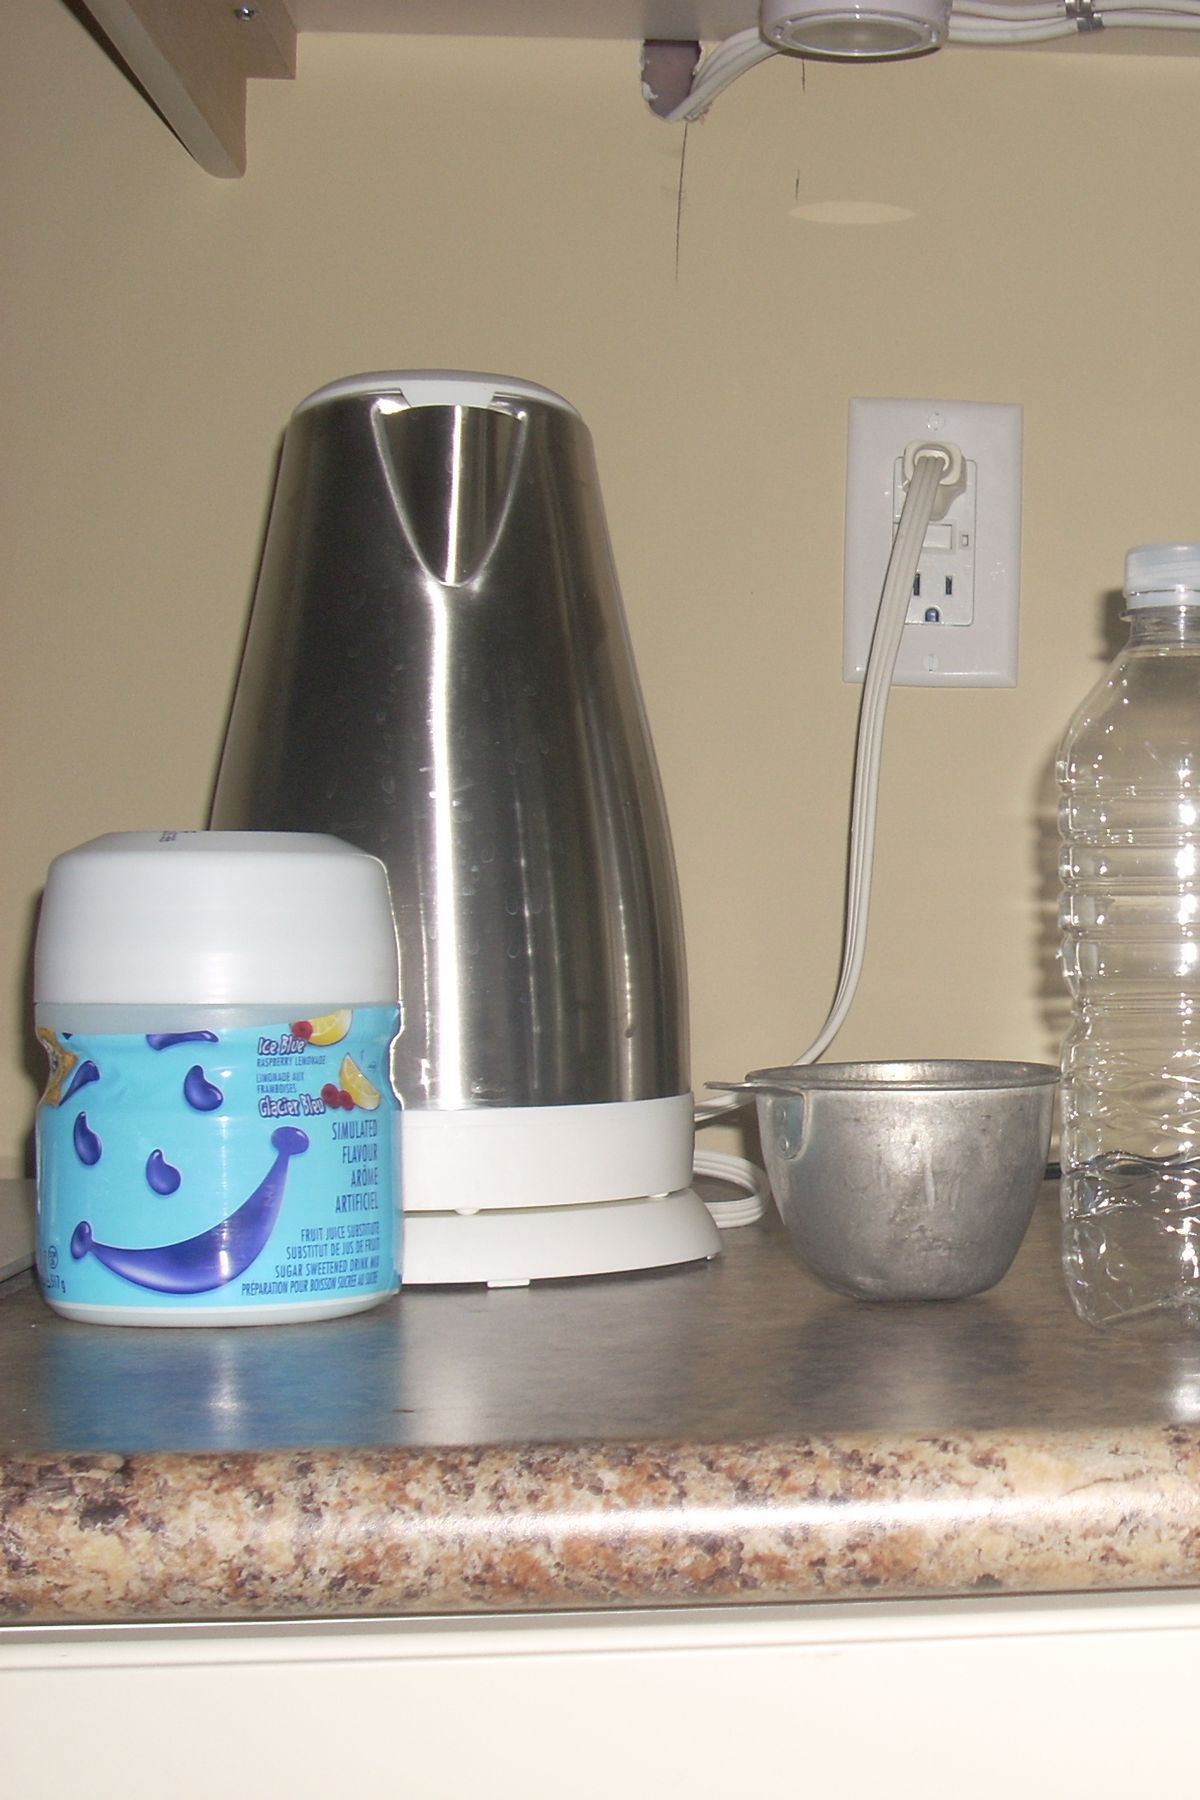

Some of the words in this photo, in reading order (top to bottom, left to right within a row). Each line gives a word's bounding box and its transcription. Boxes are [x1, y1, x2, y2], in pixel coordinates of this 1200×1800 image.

[258, 1036, 279, 1056] Ice
[279, 1033, 306, 1056] Blue
[257, 1056, 292, 1067] RASPBERRY
[295, 1055, 326, 1066] LEMONADE
[256, 1072, 290, 1083] LIMONADE
[292, 1072, 304, 1082] AUX
[257, 1083, 297, 1094] FRAMBOISES
[258, 1095, 300, 1118] Glacier
[299, 1093, 326, 1116] Bleu
[332, 1119, 378, 1140] SIMULATED
[342, 1143, 378, 1164] FLAVOUR
[351, 1164, 379, 1187] ARÔME
[335, 1191, 379, 1214] ARTIFICIEL
[300, 1227, 324, 1242] FRUIT
[325, 1225, 346, 1240] JUICE
[347, 1221, 380, 1238] SUBSTITUTE
[286, 1243, 328, 1260] SUBSTITUT
[330, 1242, 340, 1257] DE
[342, 1240, 354, 1255] JUS
[355, 1239, 364, 1253] DE
[364, 1237, 380, 1252] FRUIT
[275, 1263, 304, 1278] SUGAR
[305, 1259, 348, 1277] SWEETENED
[349, 1256, 369, 1272] DRINK
[289, 1279, 309, 1294] POUR
[309, 1276, 337, 1292] BOISSON
